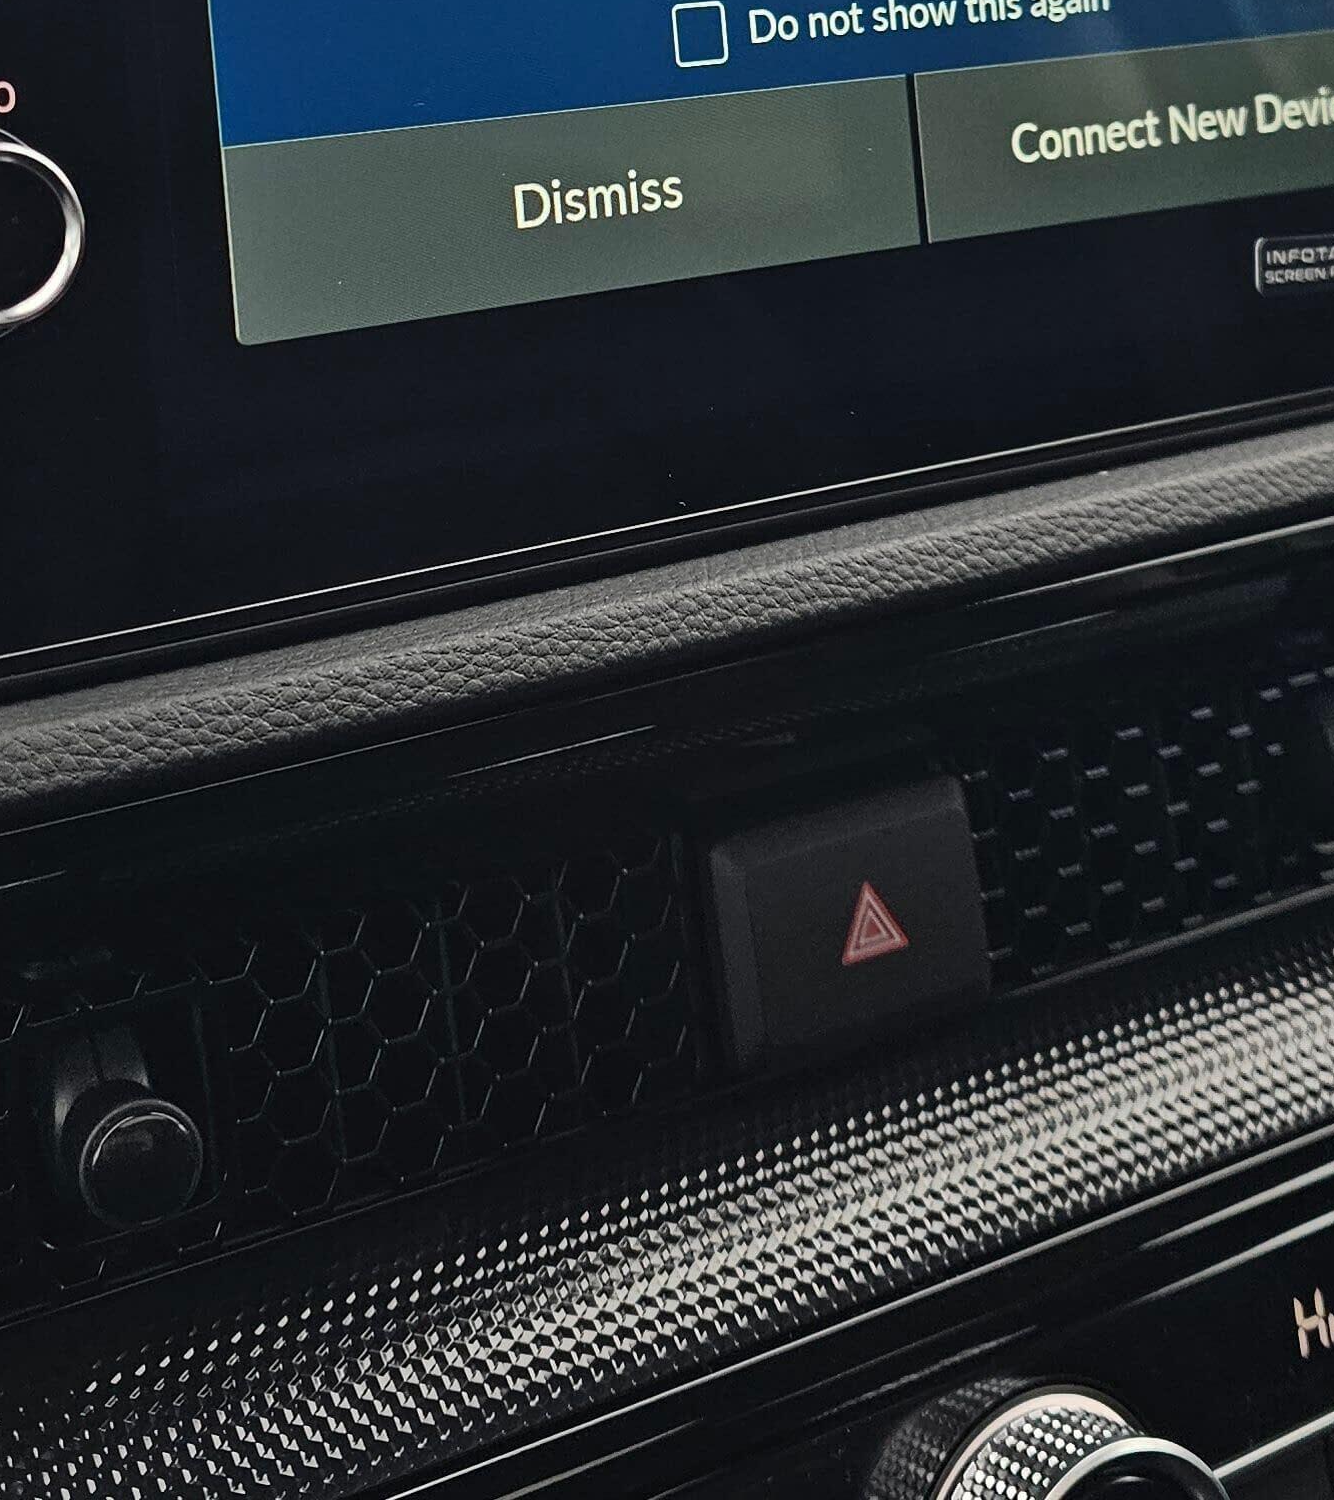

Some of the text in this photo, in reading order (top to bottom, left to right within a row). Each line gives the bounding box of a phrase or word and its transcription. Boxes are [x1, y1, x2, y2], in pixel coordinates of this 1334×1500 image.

[748, 8, 799, 44] Do
[808, 2, 865, 39] not
[1011, 109, 1163, 163] Connect
[1167, 103, 1249, 145] New
[514, 169, 683, 229] Dismiss
[1264, 267, 1327, 284] SCREEN
